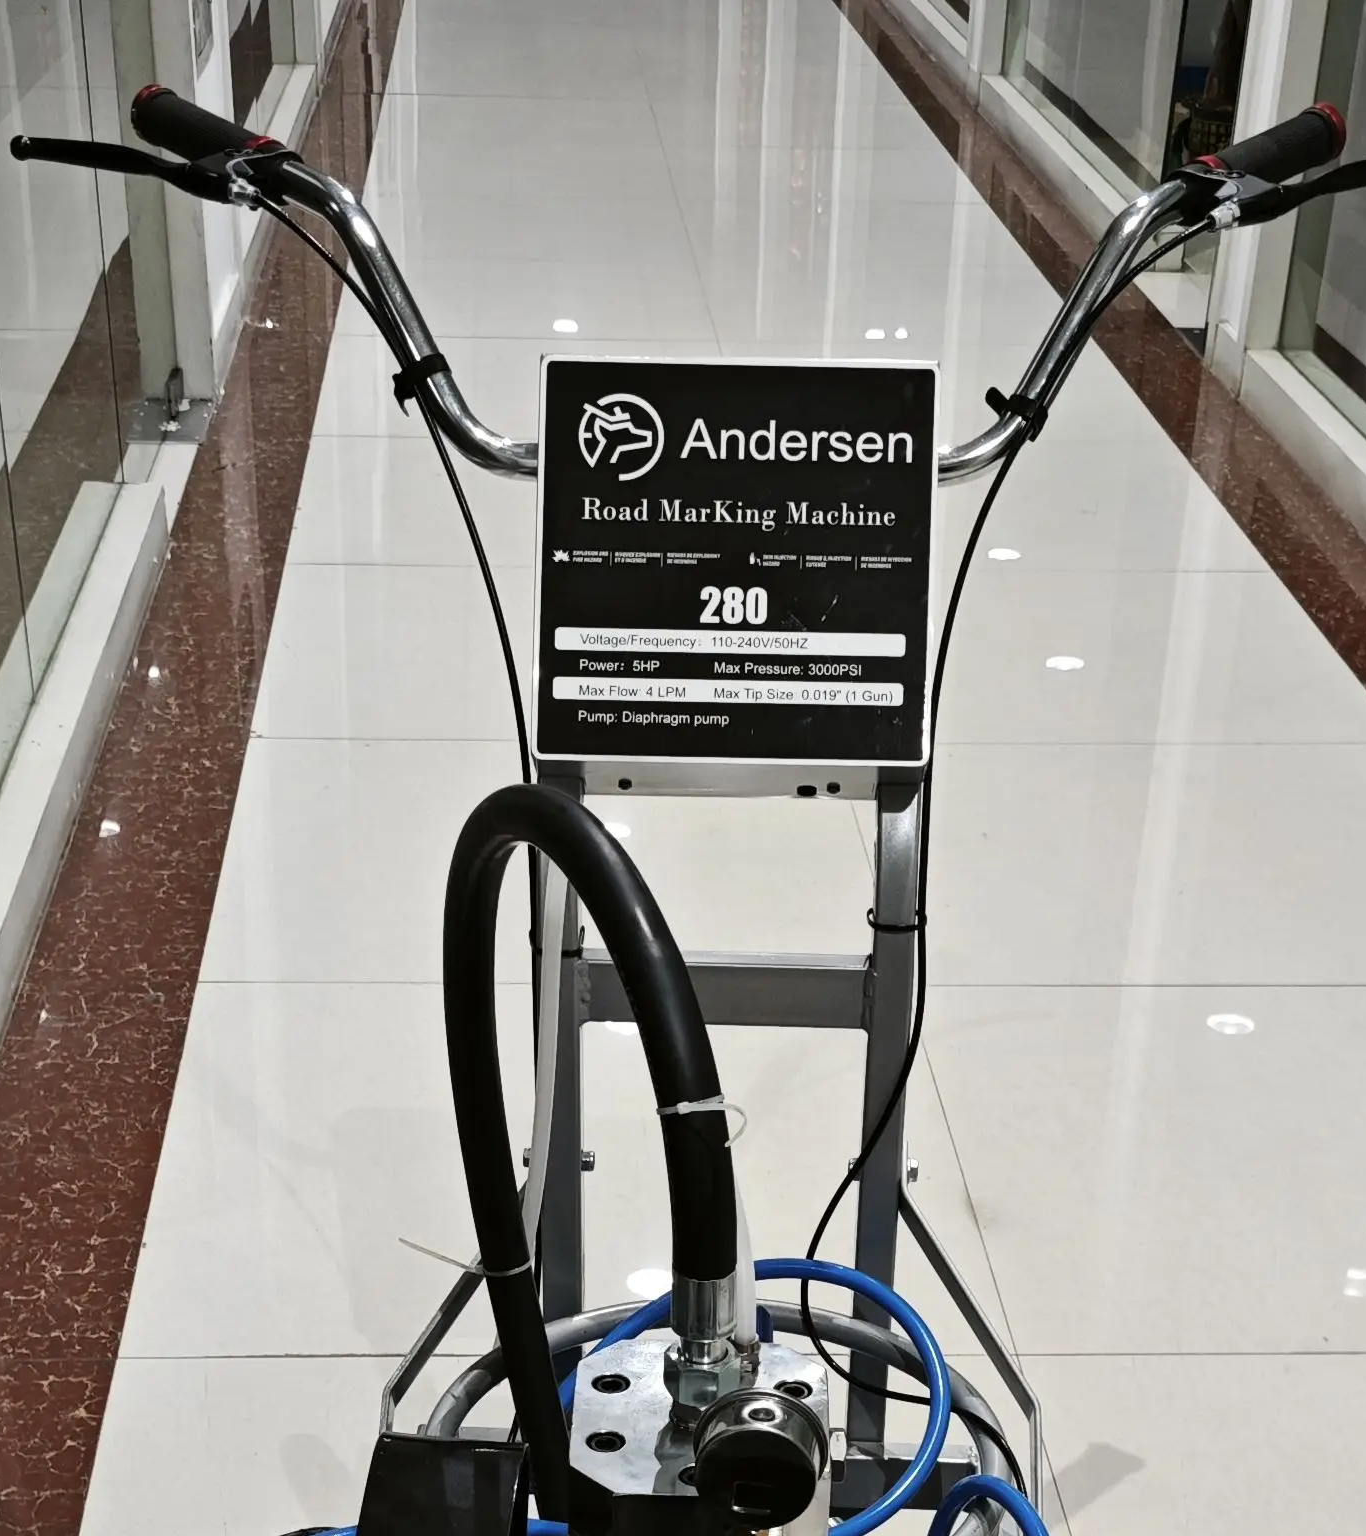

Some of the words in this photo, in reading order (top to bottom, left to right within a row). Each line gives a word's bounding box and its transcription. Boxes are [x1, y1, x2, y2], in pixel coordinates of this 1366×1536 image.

[680, 418, 912, 463] Andersen
[582, 497, 648, 521] Road
[659, 499, 776, 531] MarKing
[786, 502, 895, 526] Machine
[700, 586, 767, 624] 280
[713, 637, 808, 649] 110-240V/50HZ
[580, 659, 624, 671] Power:
[633, 660, 659, 672] 5HP
[714, 662, 740, 673] Max
[745, 662, 803, 675] Pressure:
[808, 664, 861, 676] 3000PSI
[578, 685, 604, 697] Max
[645, 687, 653, 697] 4
[658, 687, 685, 698] LPM
[714, 688, 739, 699] Max
[744, 688, 762, 702] Tip
[578, 710, 617, 725] Pump:
[622, 711, 690, 726] Diaphragm
[694, 715, 729, 727] pump
